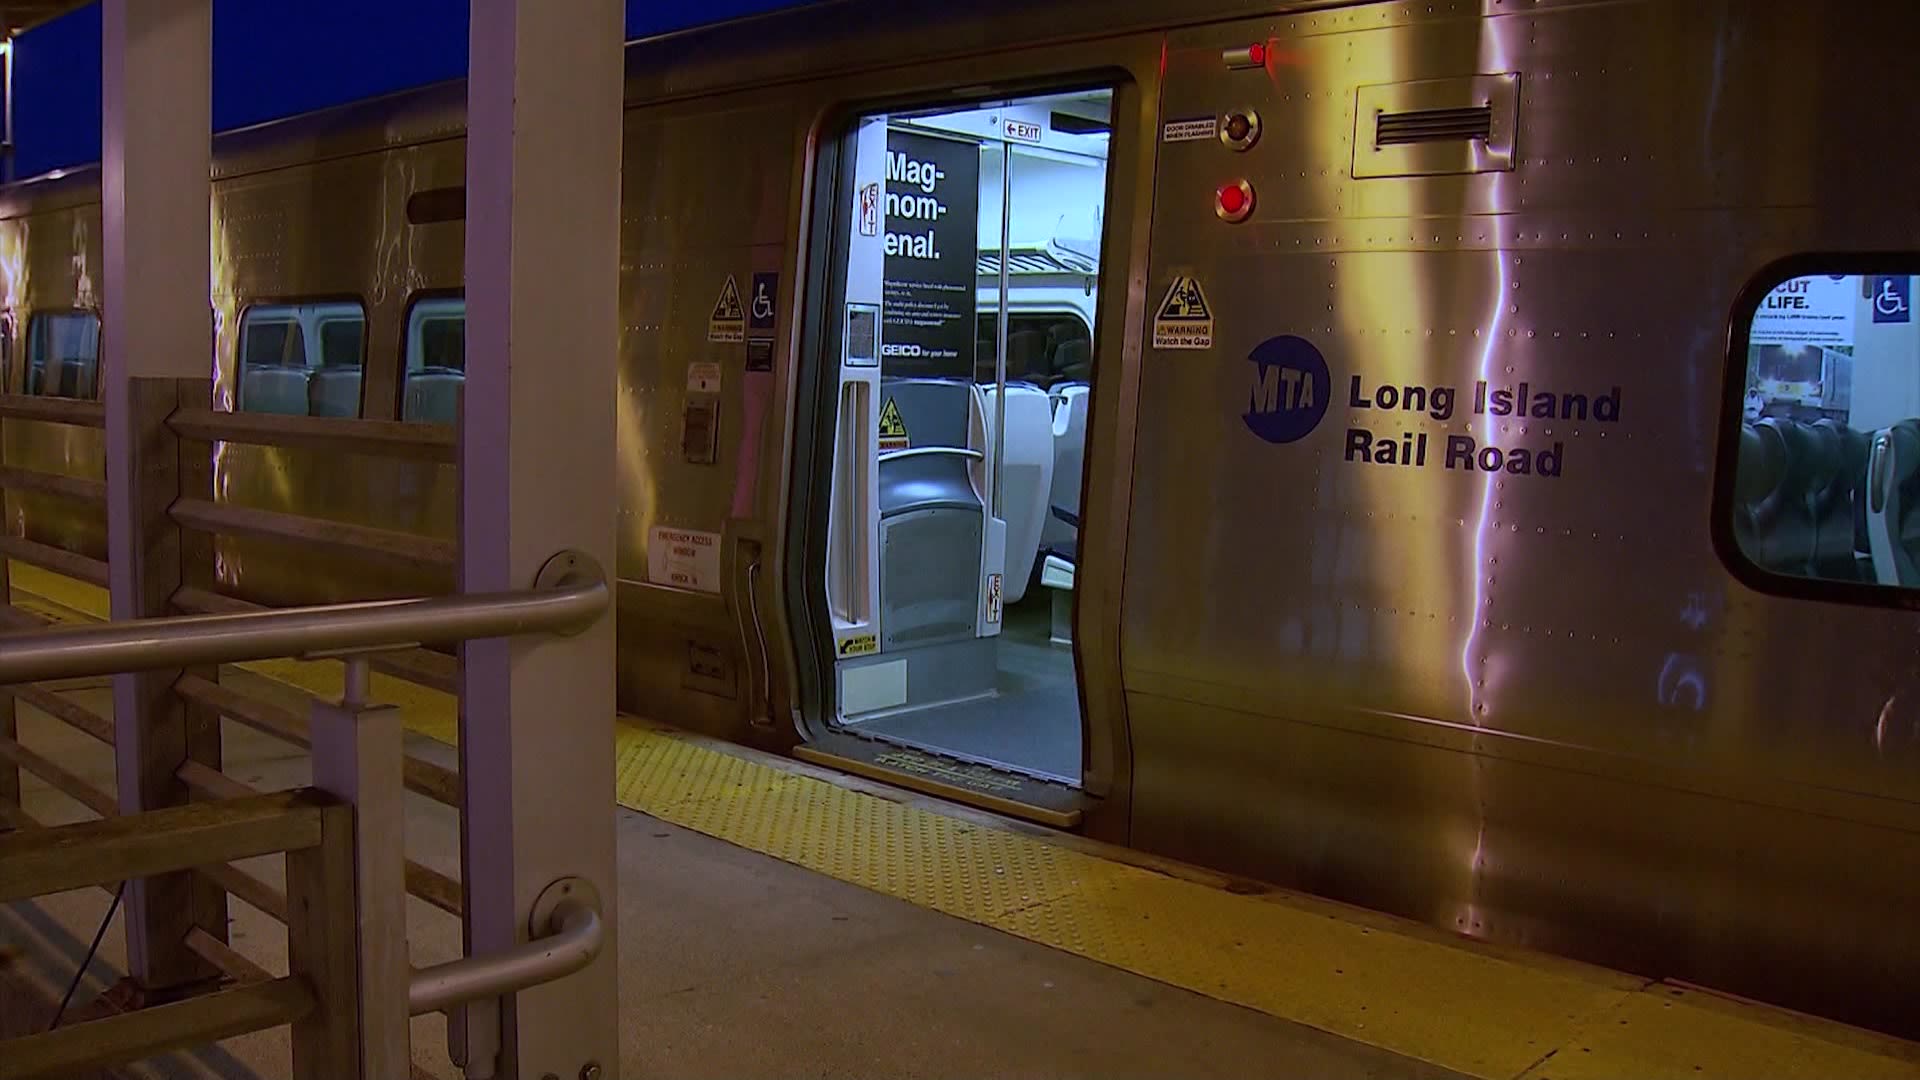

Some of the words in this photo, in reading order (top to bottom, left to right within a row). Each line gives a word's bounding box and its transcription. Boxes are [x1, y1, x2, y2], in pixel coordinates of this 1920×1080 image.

[1018, 124, 1039, 139] EXIT
[886, 151, 945, 192] Mag-
[867, 183, 877, 234] EXIT
[885, 192, 946, 220] nom-
[884, 230, 940, 260] enal.
[1767, 296, 1810, 309] LIFE.
[1156, 336, 1179, 345] Watch
[1180, 336, 1192, 345] the
[1194, 337, 1210, 346] Gap
[1167, 326, 1208, 335] WARNING
[881, 344, 921, 356] GEICO
[1349, 375, 1455, 420] Long
[1474, 380, 1622, 422] Island
[1344, 428, 1427, 467] Rail
[1445, 434, 1563, 477] Road
[992, 575, 1000, 622] EXIT
